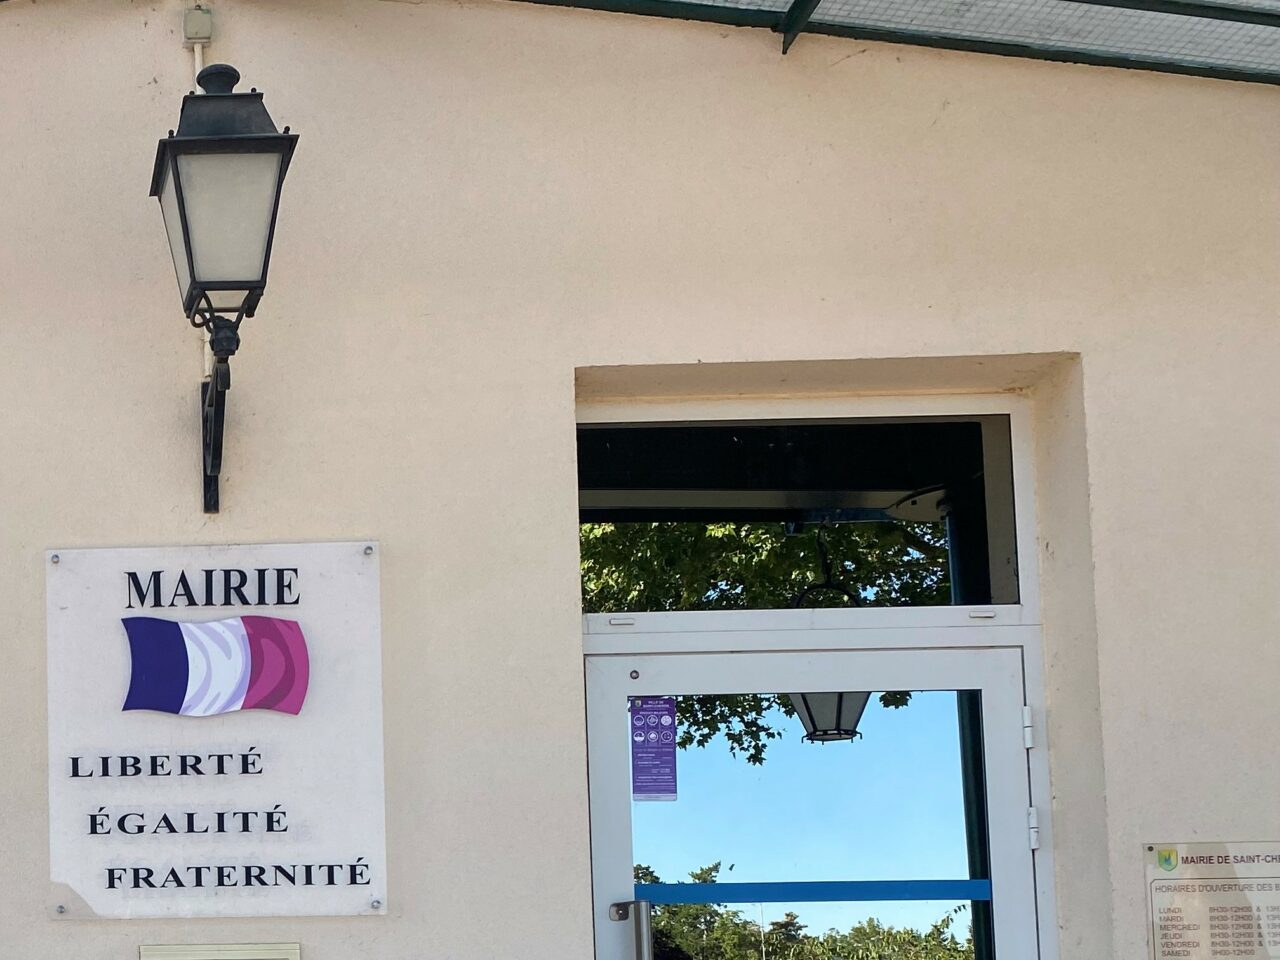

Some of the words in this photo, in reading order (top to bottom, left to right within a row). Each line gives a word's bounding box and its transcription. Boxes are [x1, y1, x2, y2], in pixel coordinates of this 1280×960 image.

[124, 567, 301, 609] MAIRIE
[68, 746, 263, 778] LIBERTÉ
[87, 804, 289, 835] ÉGALITÉ
[105, 857, 371, 889] FRATERNITÉ
[1181, 855, 1214, 865] MAIRIE
[1217, 855, 1231, 864] DE
[1233, 854, 1280, 864] SAINT-CH
[1155, 884, 1197, 893] HORAIRES
[1198, 883, 1254, 893] D'OUVERTURE
[1256, 883, 1273, 892] DES
[1162, 949, 1191, 957] SAMEDI
